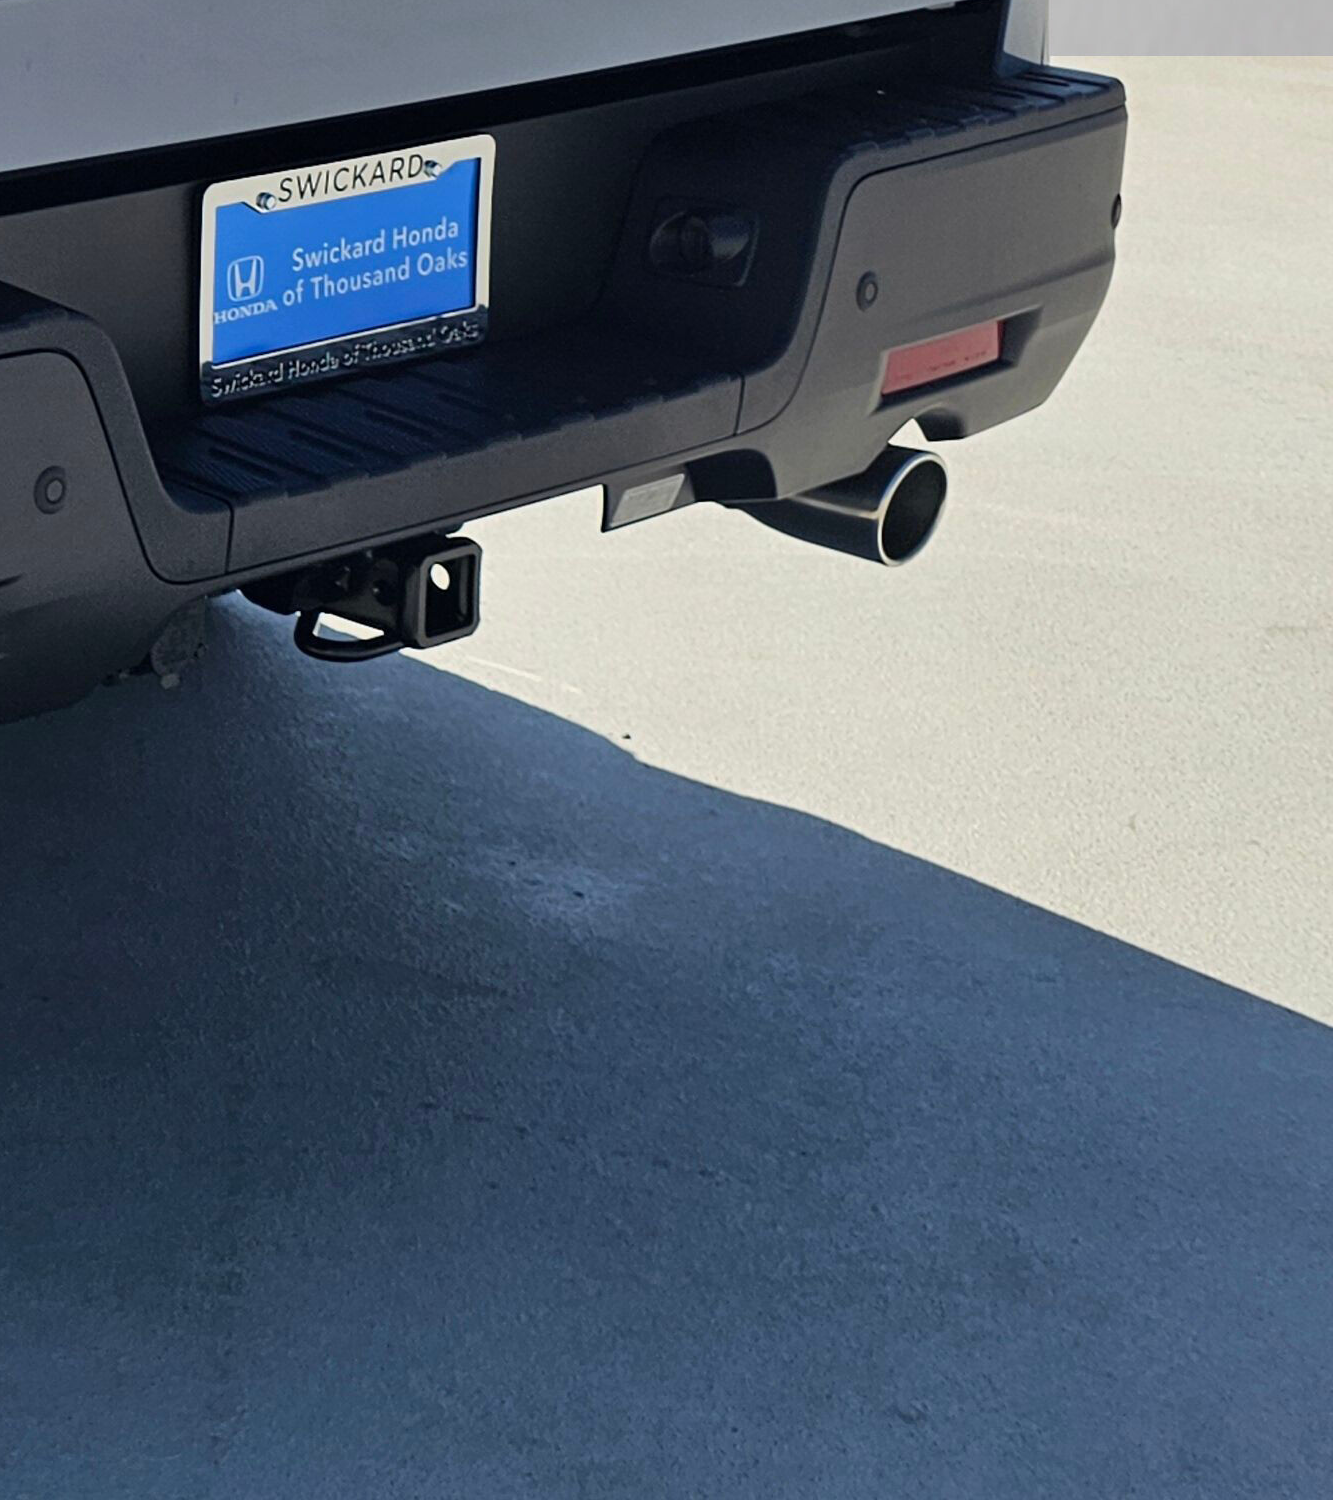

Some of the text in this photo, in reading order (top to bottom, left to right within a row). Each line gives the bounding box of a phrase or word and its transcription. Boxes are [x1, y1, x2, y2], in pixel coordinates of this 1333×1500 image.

[278, 153, 425, 203] SWICKARD
[292, 216, 459, 272] Swickard Honda
[282, 247, 469, 306] of Thousand Oaks
[214, 298, 278, 325] HONDA
